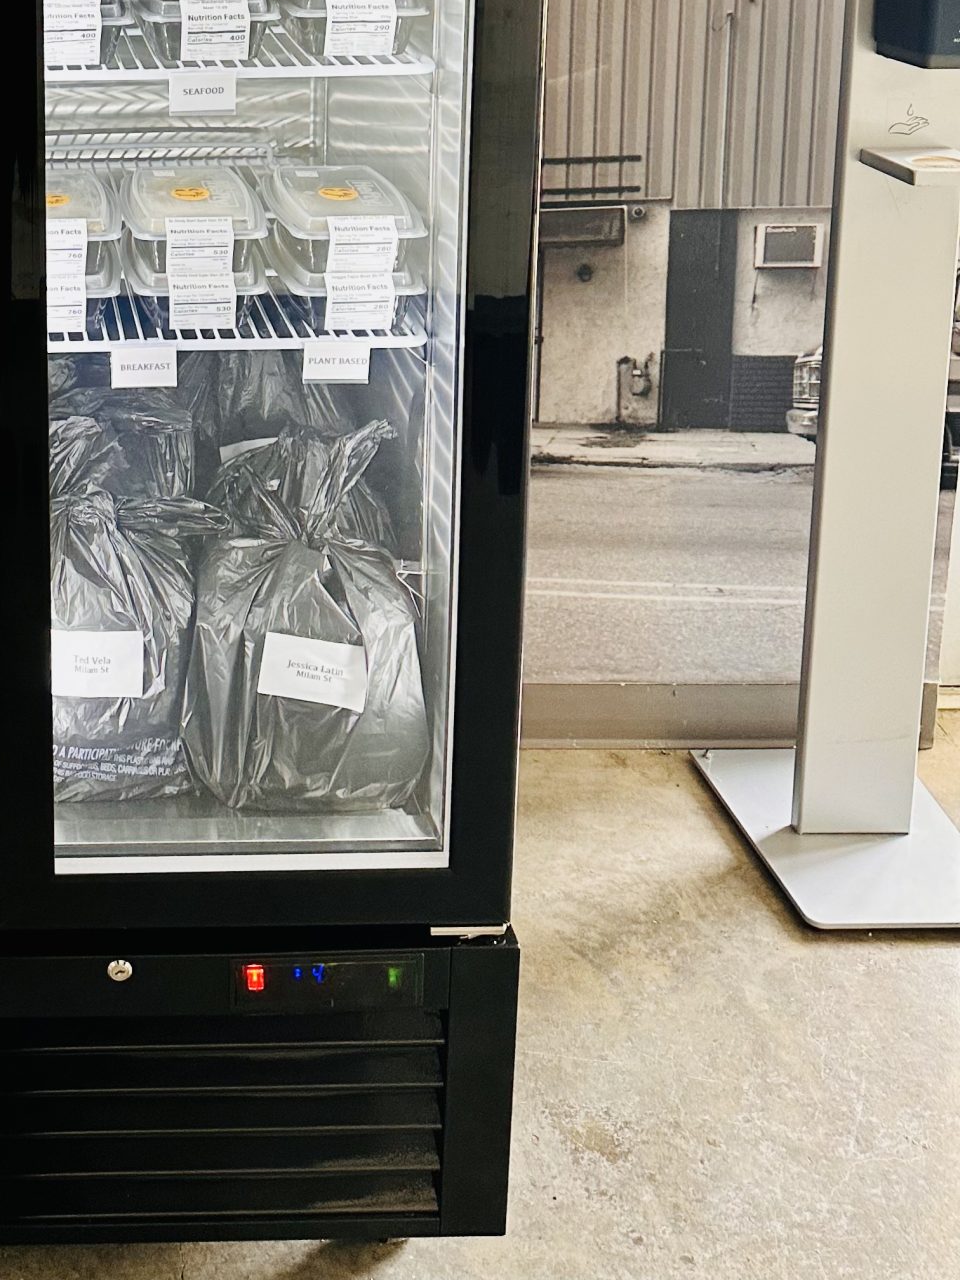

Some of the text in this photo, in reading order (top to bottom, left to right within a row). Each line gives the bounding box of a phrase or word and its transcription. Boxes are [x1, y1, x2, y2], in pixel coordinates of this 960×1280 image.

[183, 87, 224, 96] SEAFOOD
[120, 363, 171, 371] BREAKFAST
[74, 655, 111, 665] Ted Vela
[287, 660, 343, 676] Jessica Latin
[296, 670, 321, 680] Milam
